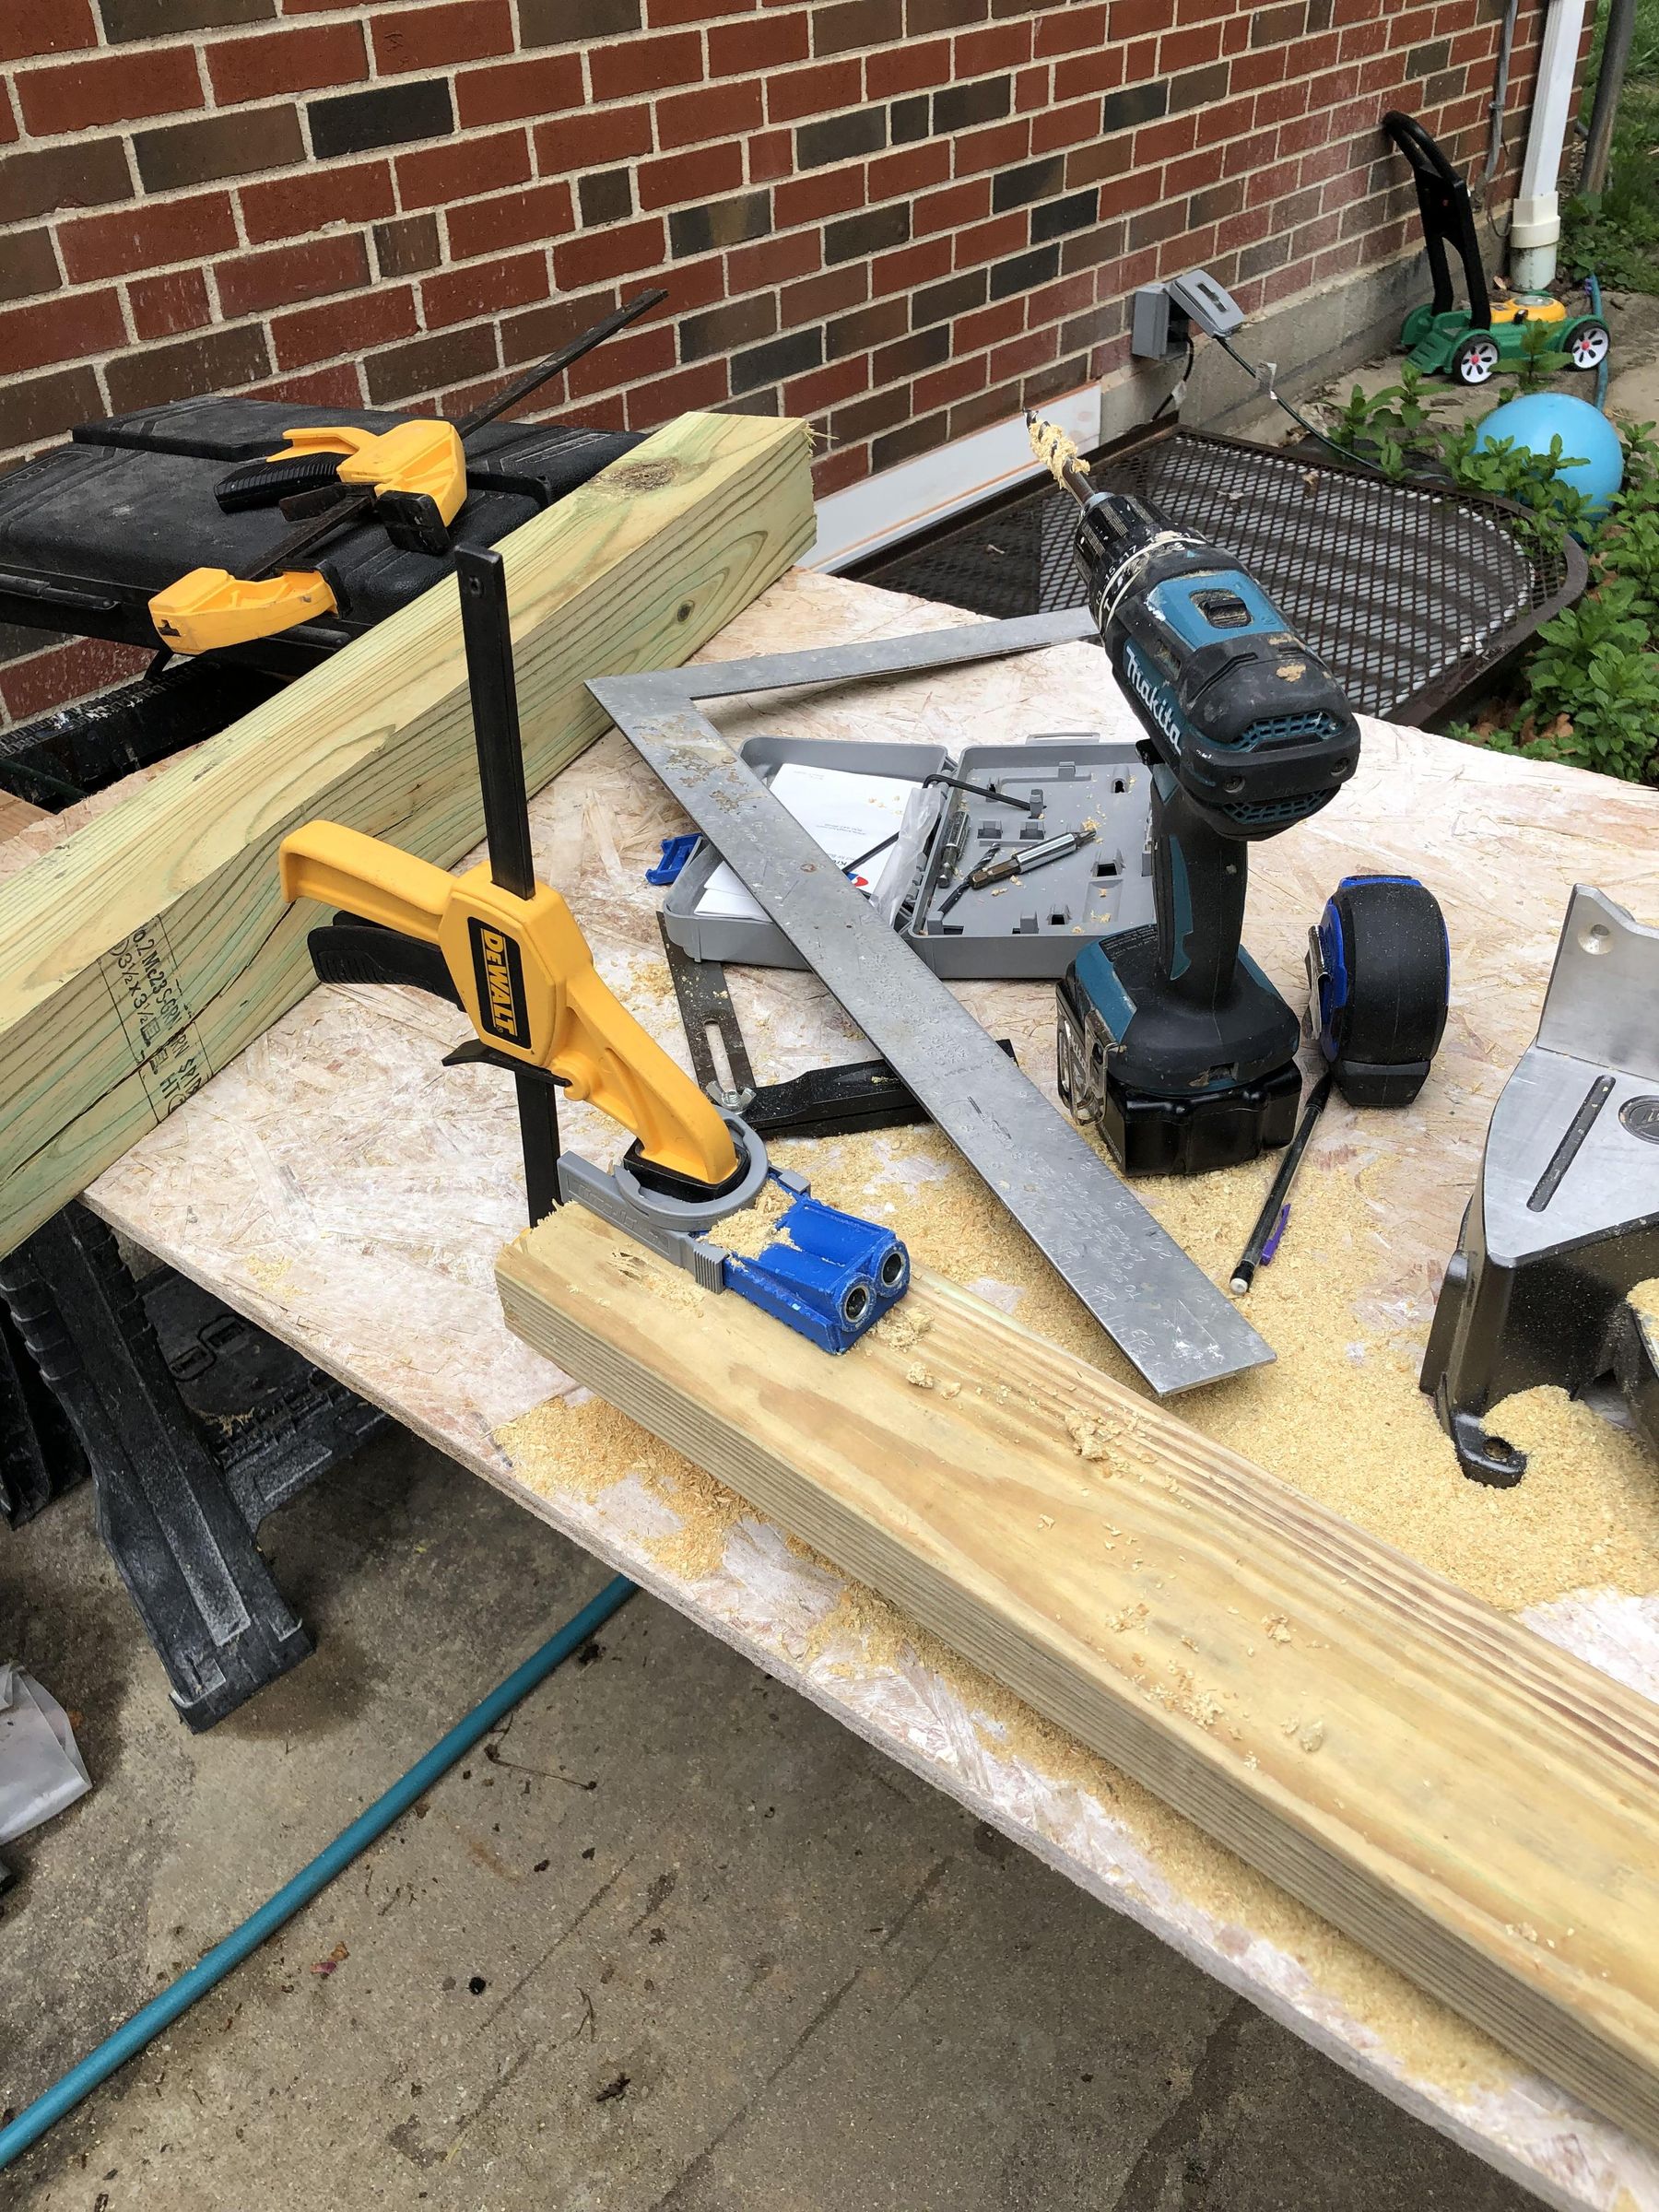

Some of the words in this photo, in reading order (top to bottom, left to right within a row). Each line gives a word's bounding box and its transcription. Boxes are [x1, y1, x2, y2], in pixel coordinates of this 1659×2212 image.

[1124, 545, 1137, 558] 17
[1126, 646, 1182, 756] Makita
[483, 929, 515, 1036] DEWALT
